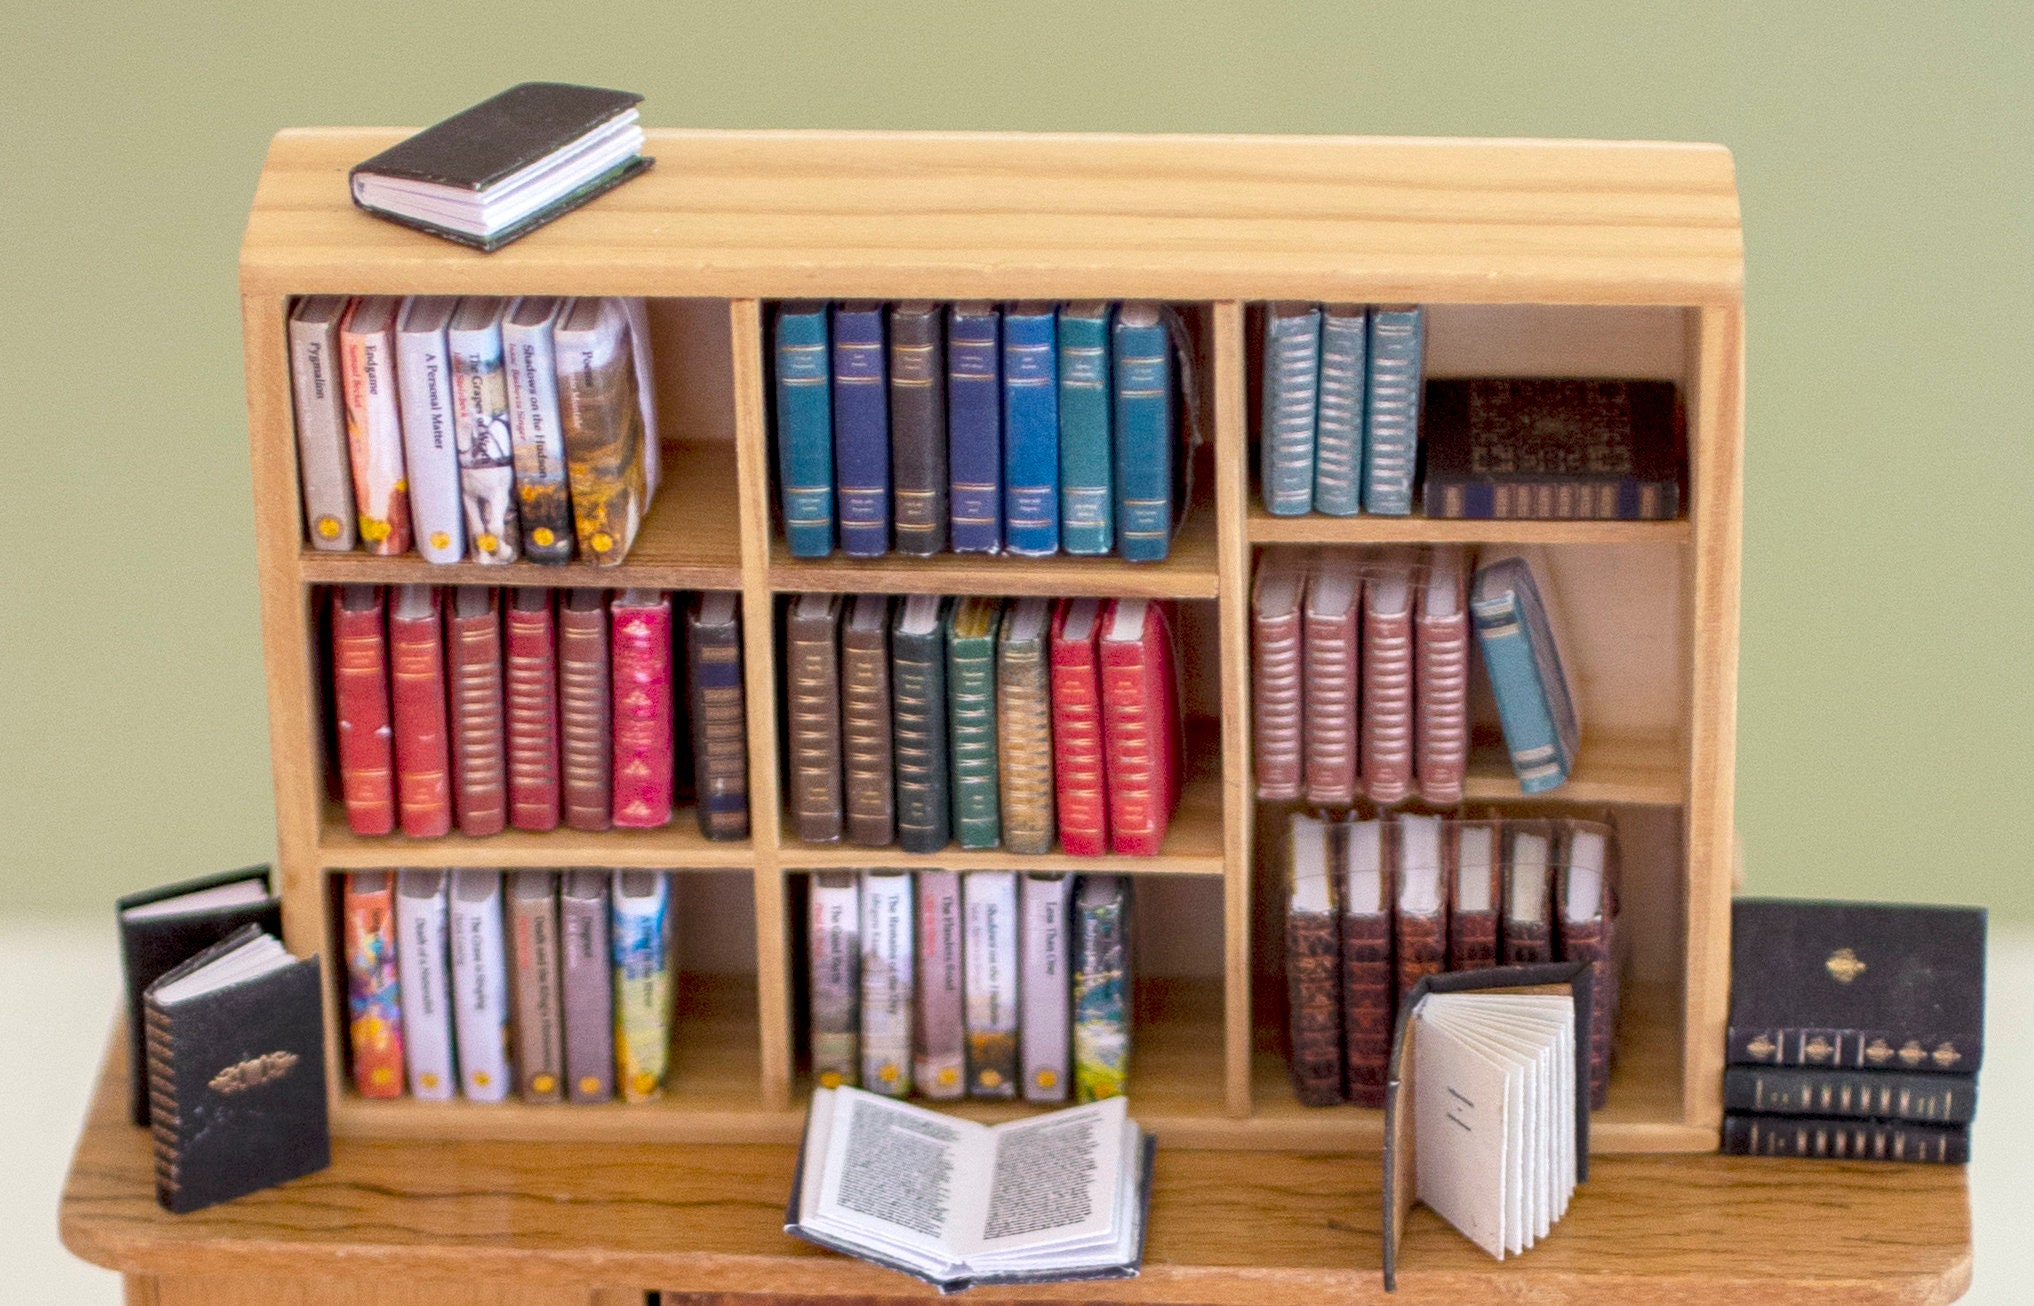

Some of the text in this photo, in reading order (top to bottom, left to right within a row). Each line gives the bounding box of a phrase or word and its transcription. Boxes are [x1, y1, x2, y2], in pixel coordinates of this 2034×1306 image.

[308, 342, 325, 399] Pygmalion
[365, 345, 378, 395] Endgame
[469, 353, 480, 373] The
[426, 353, 443, 449] A Personal Matter
[471, 376, 484, 414] Grapes
[523, 344, 548, 478] Shadows on the Hudson
[477, 418, 487, 428] of
[889, 895, 899, 913] The
